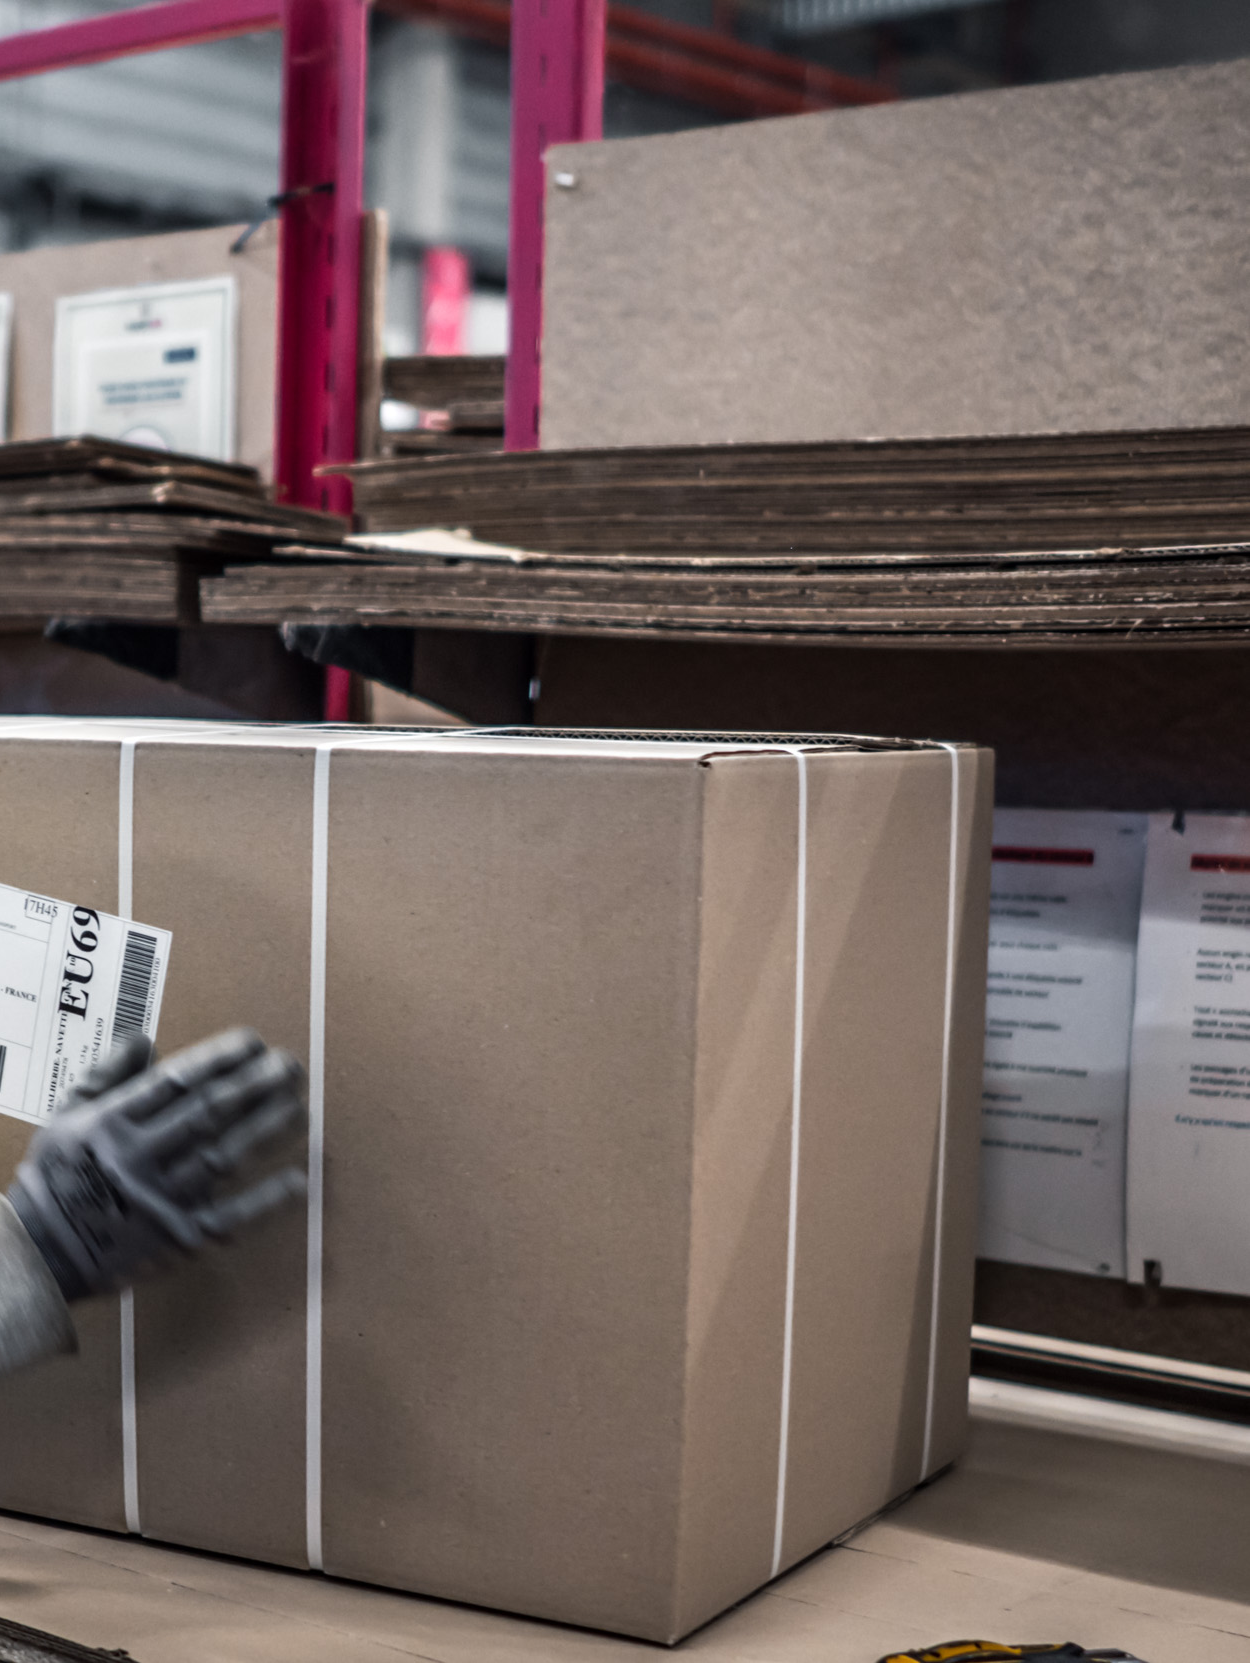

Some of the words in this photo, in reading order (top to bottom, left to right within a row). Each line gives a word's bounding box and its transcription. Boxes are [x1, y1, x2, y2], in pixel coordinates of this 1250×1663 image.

[24, 898, 59, 918] 17H45
[58, 905, 101, 1021] EU69
[5, 986, 36, 1002] FRANCE
